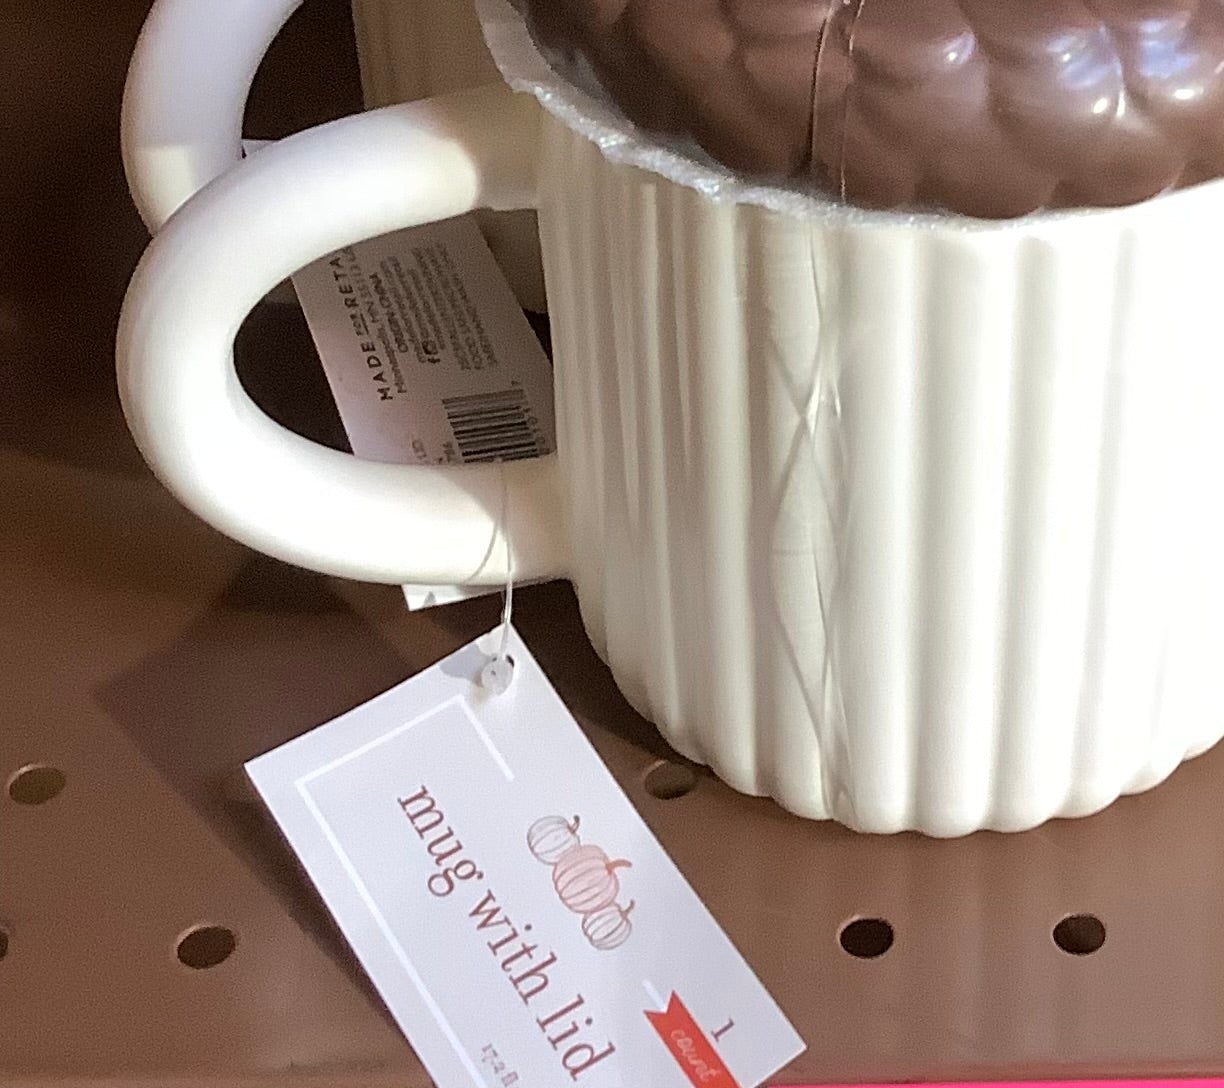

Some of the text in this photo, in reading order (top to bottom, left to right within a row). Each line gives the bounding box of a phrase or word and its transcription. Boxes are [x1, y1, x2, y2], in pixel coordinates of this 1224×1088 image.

[329, 255, 359, 309] RETA
[360, 340, 393, 401] MADE
[397, 784, 616, 1081] mug with lid
[669, 1028, 721, 1083] count
[710, 1017, 736, 1043] 1
